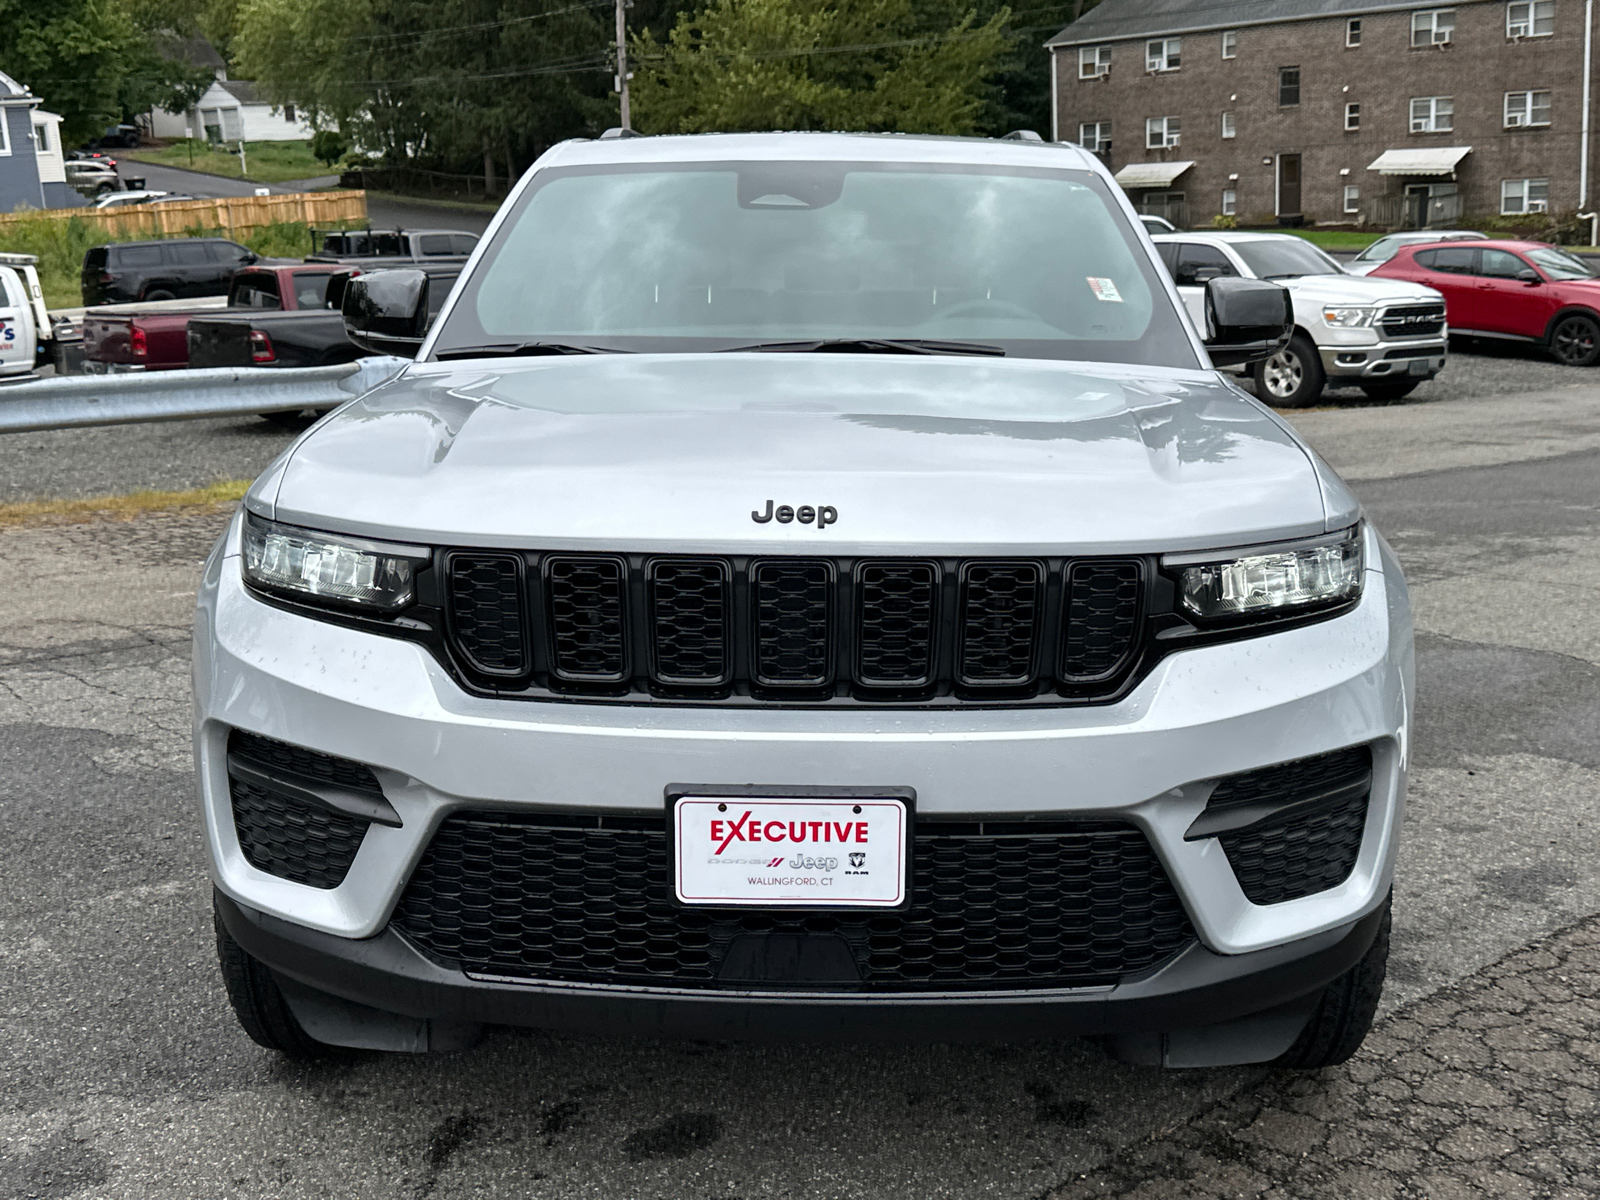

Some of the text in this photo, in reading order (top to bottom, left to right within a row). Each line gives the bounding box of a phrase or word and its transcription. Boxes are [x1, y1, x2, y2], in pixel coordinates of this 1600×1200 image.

[751, 499, 838, 529] Jeep
[711, 810, 868, 855] EXECUTIVE
[789, 853, 838, 872] Jeep
[747, 876, 834, 886] WALLINGFORD, CT
